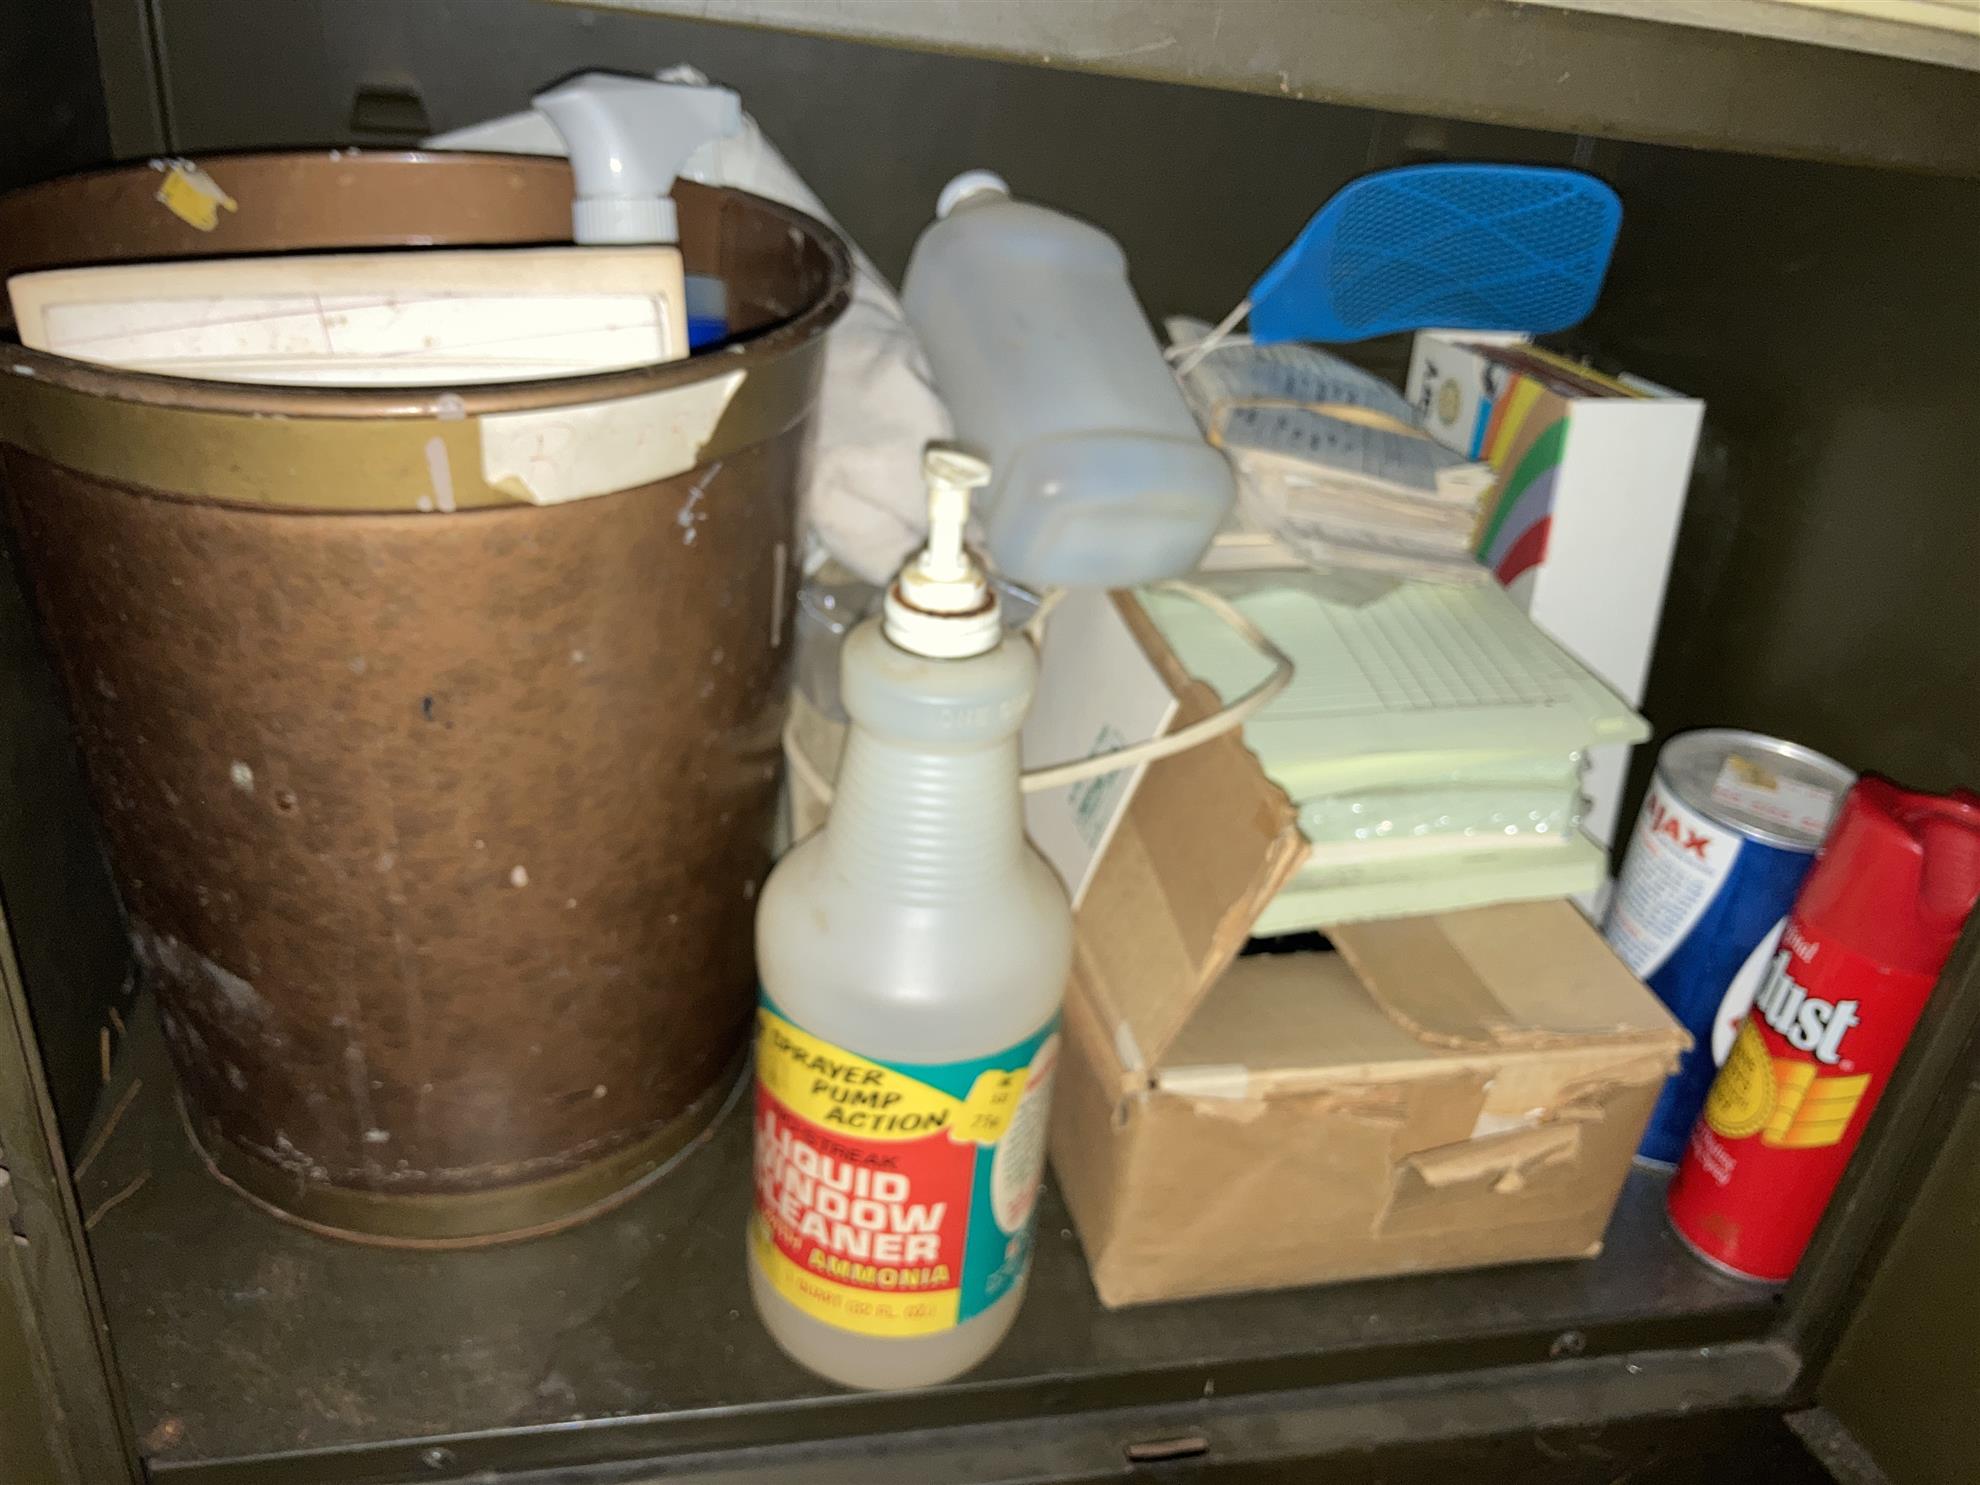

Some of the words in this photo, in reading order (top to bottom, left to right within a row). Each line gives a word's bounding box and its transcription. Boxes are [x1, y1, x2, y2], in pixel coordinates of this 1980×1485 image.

[771, 1028, 885, 1087] SPRAYER
[810, 1078, 902, 1109] PUMP
[824, 1106, 949, 1132] ACTION
[764, 1110, 911, 1206] LIQUID
[807, 1247, 951, 1288] AMMONIA
